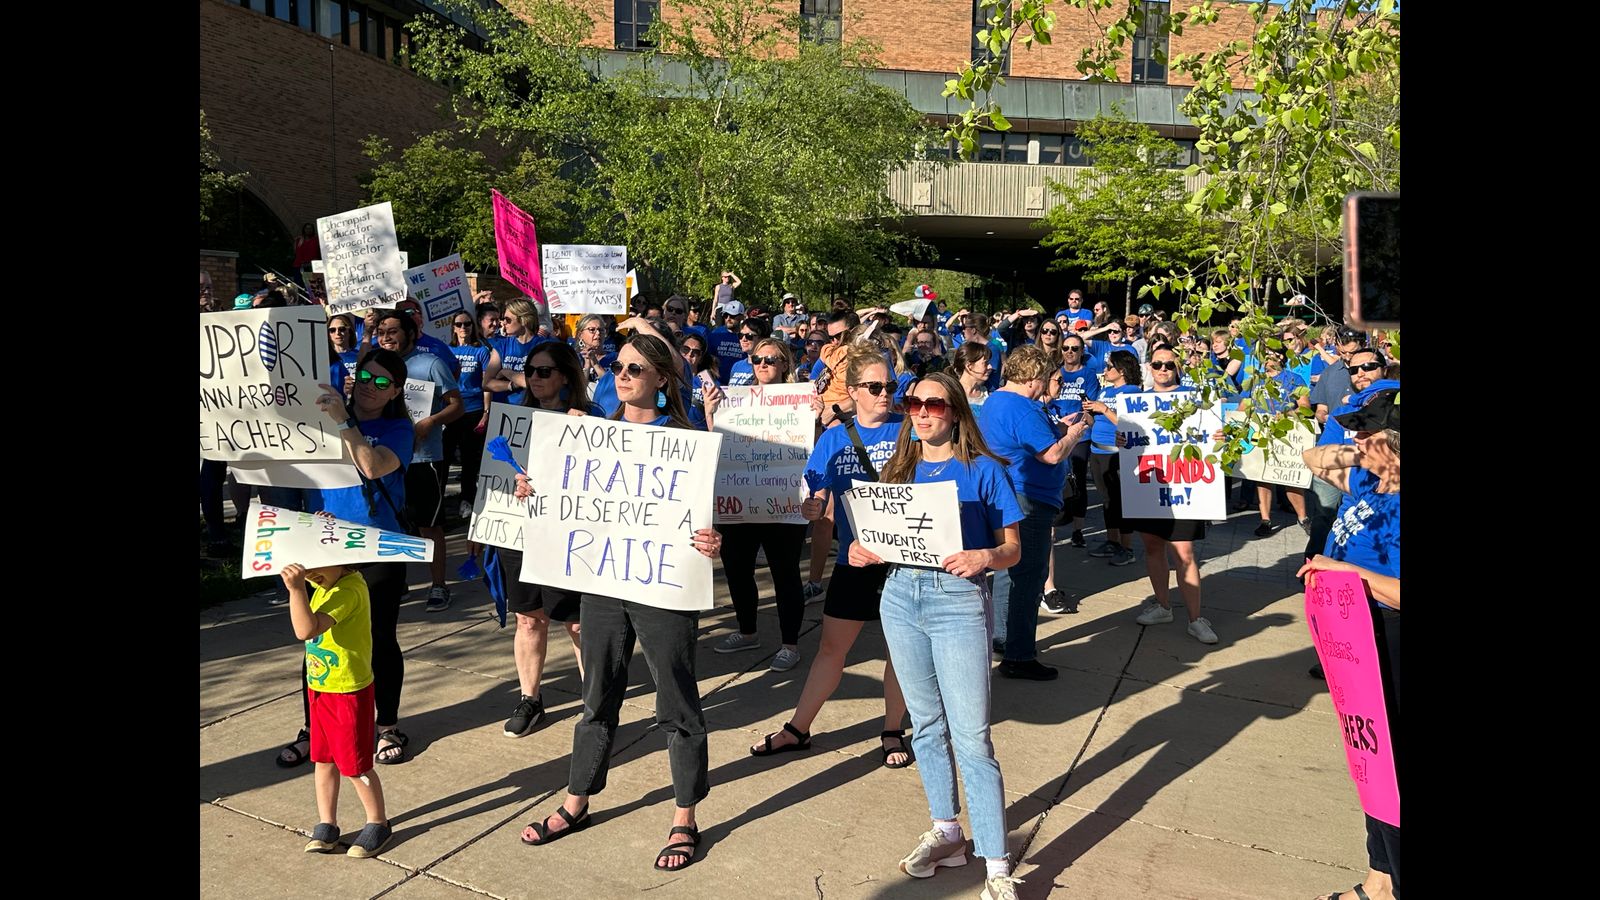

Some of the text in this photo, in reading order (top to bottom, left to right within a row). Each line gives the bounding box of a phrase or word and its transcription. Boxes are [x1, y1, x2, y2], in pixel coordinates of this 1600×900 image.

[545, 249, 550, 259] I
[410, 260, 460, 285] WE TEACH
[544, 264, 548, 274] I
[415, 276, 462, 301] WE CARE
[545, 277, 549, 287] I
[329, 304, 345, 314] PAY
[346, 302, 357, 311] US
[360, 298, 380, 308] OUR
[434, 315, 455, 329] SHA
[238, 382, 303, 410] ARBOR
[1125, 396, 1149, 413] We
[769, 411, 800, 430] Layoffs
[499, 413, 533, 449] DE
[761, 430, 780, 444] Class
[786, 430, 807, 443] Sizes
[558, 424, 698, 463] MORE THAN
[843, 440, 896, 455] SUPORT
[751, 447, 783, 463] targeted
[788, 447, 810, 461] Stud
[834, 449, 897, 466] ANN RBO
[746, 460, 769, 473] Time
[1138, 454, 1216, 484] FUNDS
[562, 454, 689, 502] PRAISE
[755, 472, 788, 492] Learning
[847, 485, 914, 502] TEACHERS
[1159, 487, 1193, 507] Hun!
[527, 495, 695, 536] WE DESERVE A
[748, 497, 760, 515] for
[766, 497, 804, 515] Studen
[872, 499, 907, 515] LAST
[339, 525, 367, 550] you
[475, 516, 511, 544] CUTS
[861, 528, 927, 551] STUDENTS
[565, 529, 684, 589] RAISE
[900, 549, 941, 565] FIRST
[1340, 710, 1378, 755] HERS
